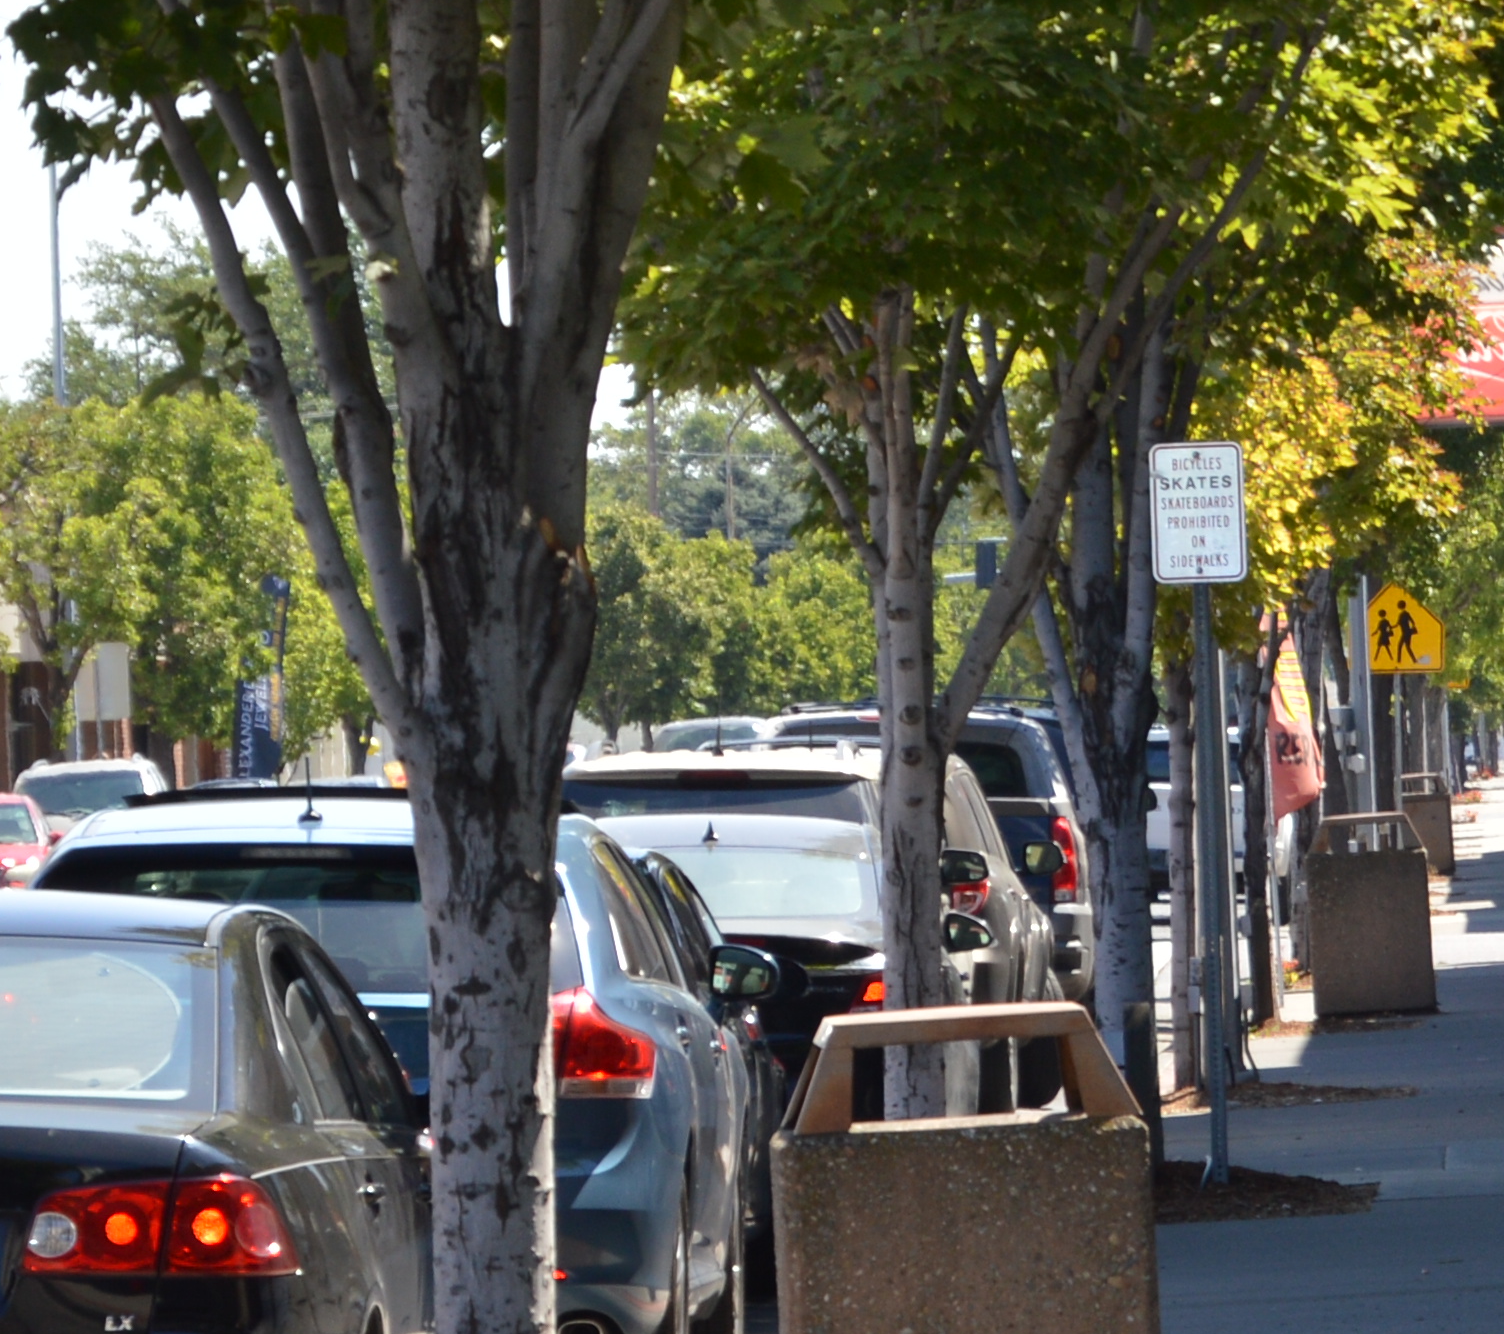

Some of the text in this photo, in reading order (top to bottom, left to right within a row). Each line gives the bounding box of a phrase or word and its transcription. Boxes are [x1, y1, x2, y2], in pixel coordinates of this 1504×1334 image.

[1171, 457, 1222, 471] BICYCLES
[1159, 475, 1232, 490] SKATES
[1160, 495, 1235, 510] SKATEBOARDS
[1167, 515, 1230, 529] PROHIBITED
[1191, 535, 1206, 548] ON
[1169, 554, 1229, 568] SIDEWALKS
[238, 691, 255, 777] LEXANDER
[104, 1315, 135, 1332] LX
